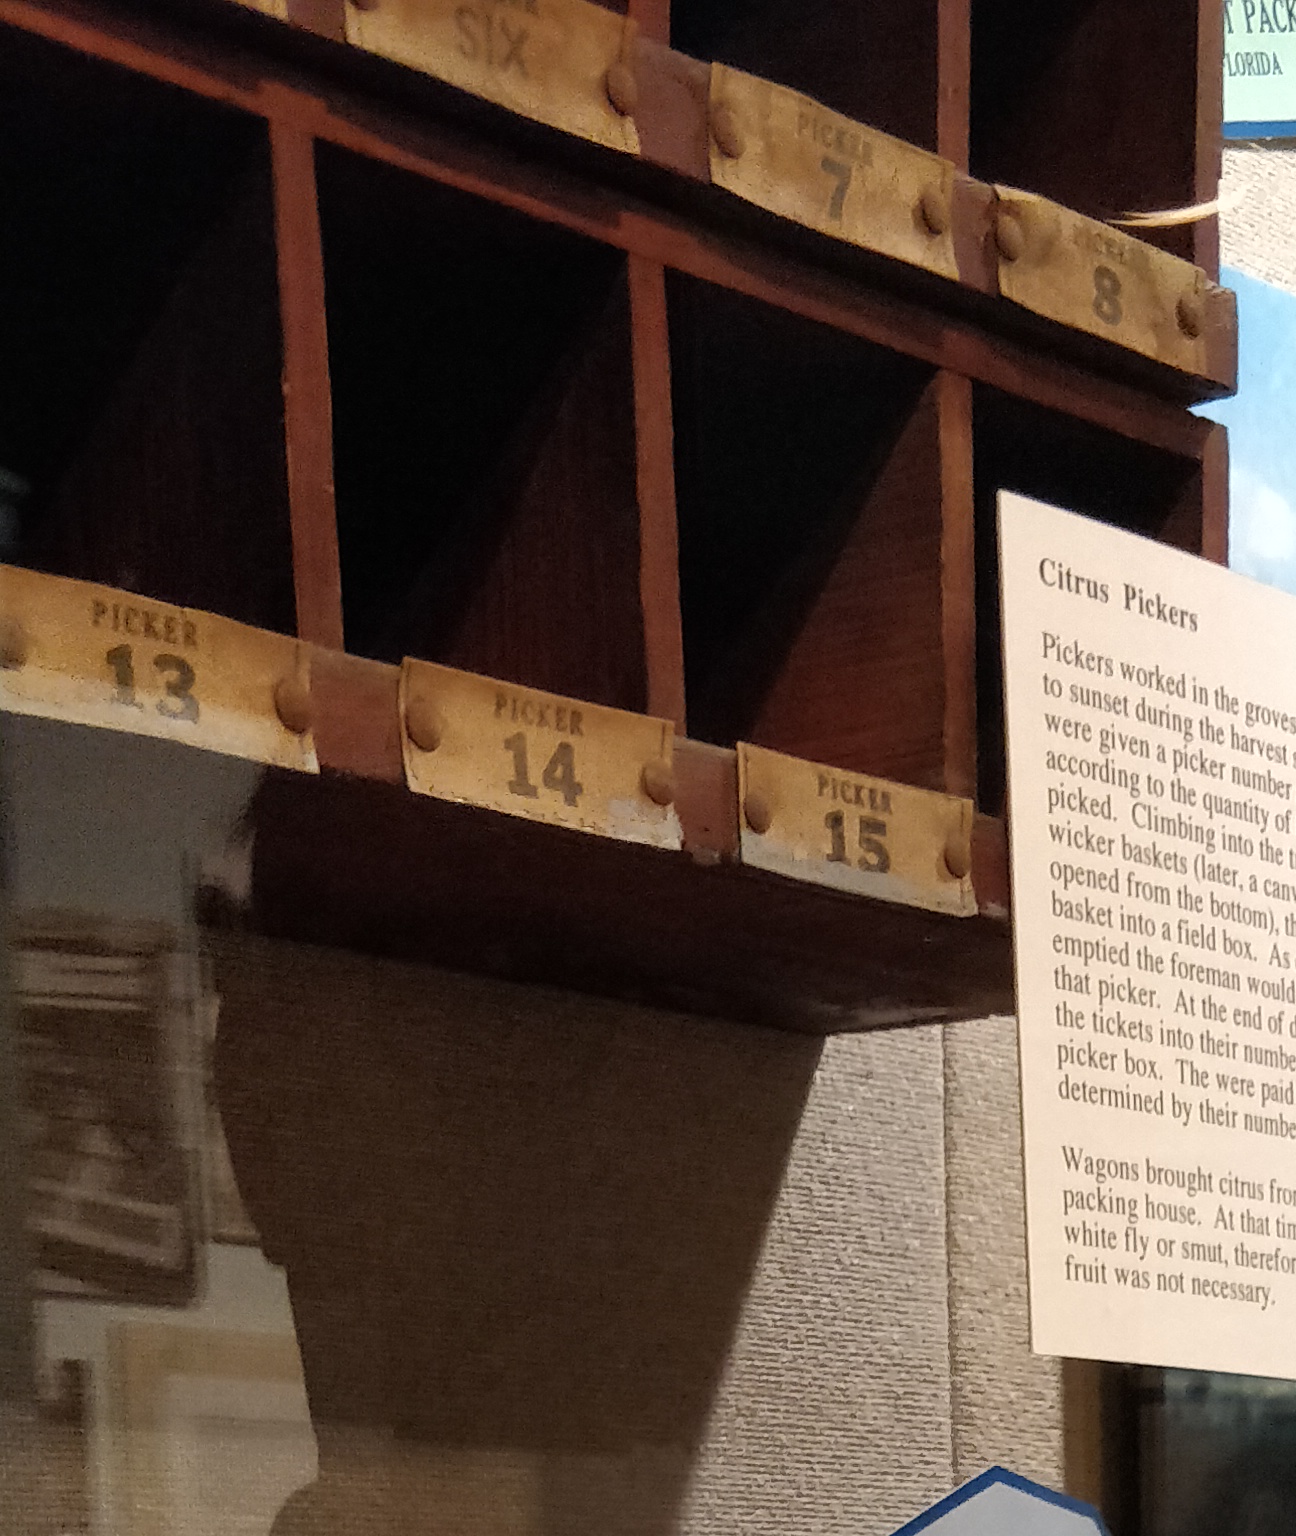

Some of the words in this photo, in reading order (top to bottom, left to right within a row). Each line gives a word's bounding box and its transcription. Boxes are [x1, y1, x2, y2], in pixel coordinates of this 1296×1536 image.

[455, 5, 531, 76] SIX
[1223, 51, 1284, 77] LORIDA
[820, 156, 852, 220] 7
[1092, 264, 1123, 326] 8
[91, 600, 198, 647] PICKER
[1037, 556, 1111, 605] Citrus
[1122, 581, 1199, 634] Pickers
[106, 643, 200, 724] 13
[1040, 630, 1115, 678] Pickers
[1118, 660, 1188, 700] worked
[1191, 683, 1210, 708] in
[1212, 685, 1240, 717] the
[494, 691, 583, 736] PICKER
[1041, 671, 1064, 700] to
[1068, 682, 1130, 719] sunset
[1134, 696, 1195, 744] during
[1197, 715, 1226, 747] the
[1229, 723, 1289, 767] harvest
[503, 731, 584, 807] 14
[1043, 711, 1093, 744] were
[1097, 727, 1151, 760] given
[1155, 743, 1168, 765] a
[1171, 747, 1227, 782] picker
[1230, 764, 1294, 802] number
[816, 772, 894, 815] PICKER
[1044, 749, 1142, 800] according
[1145, 772, 1166, 799] to
[1169, 777, 1198, 808] the
[1201, 791, 1271, 835] quantity
[1273, 808, 1294, 836] of
[825, 809, 891, 874] 15
[1060, 1144, 1141, 1186] Wagons
[1144, 1157, 1215, 1199] brought
[1217, 1175, 1266, 1202] citrus
[1061, 1184, 1140, 1226] packing
[1143, 1192, 1203, 1227] house.
[1212, 1203, 1236, 1233] At
[1239, 1208, 1272, 1238] that
[1063, 1218, 1119, 1251] white
[1123, 1225, 1150, 1263] fly
[1155, 1237, 1177, 1259] or
[1180, 1239, 1230, 1269] smut,
[1063, 1252, 1109, 1286] fruit
[1112, 1266, 1152, 1291] was
[1155, 1271, 1186, 1295] not
[1190, 1276, 1277, 1313] necessary.
